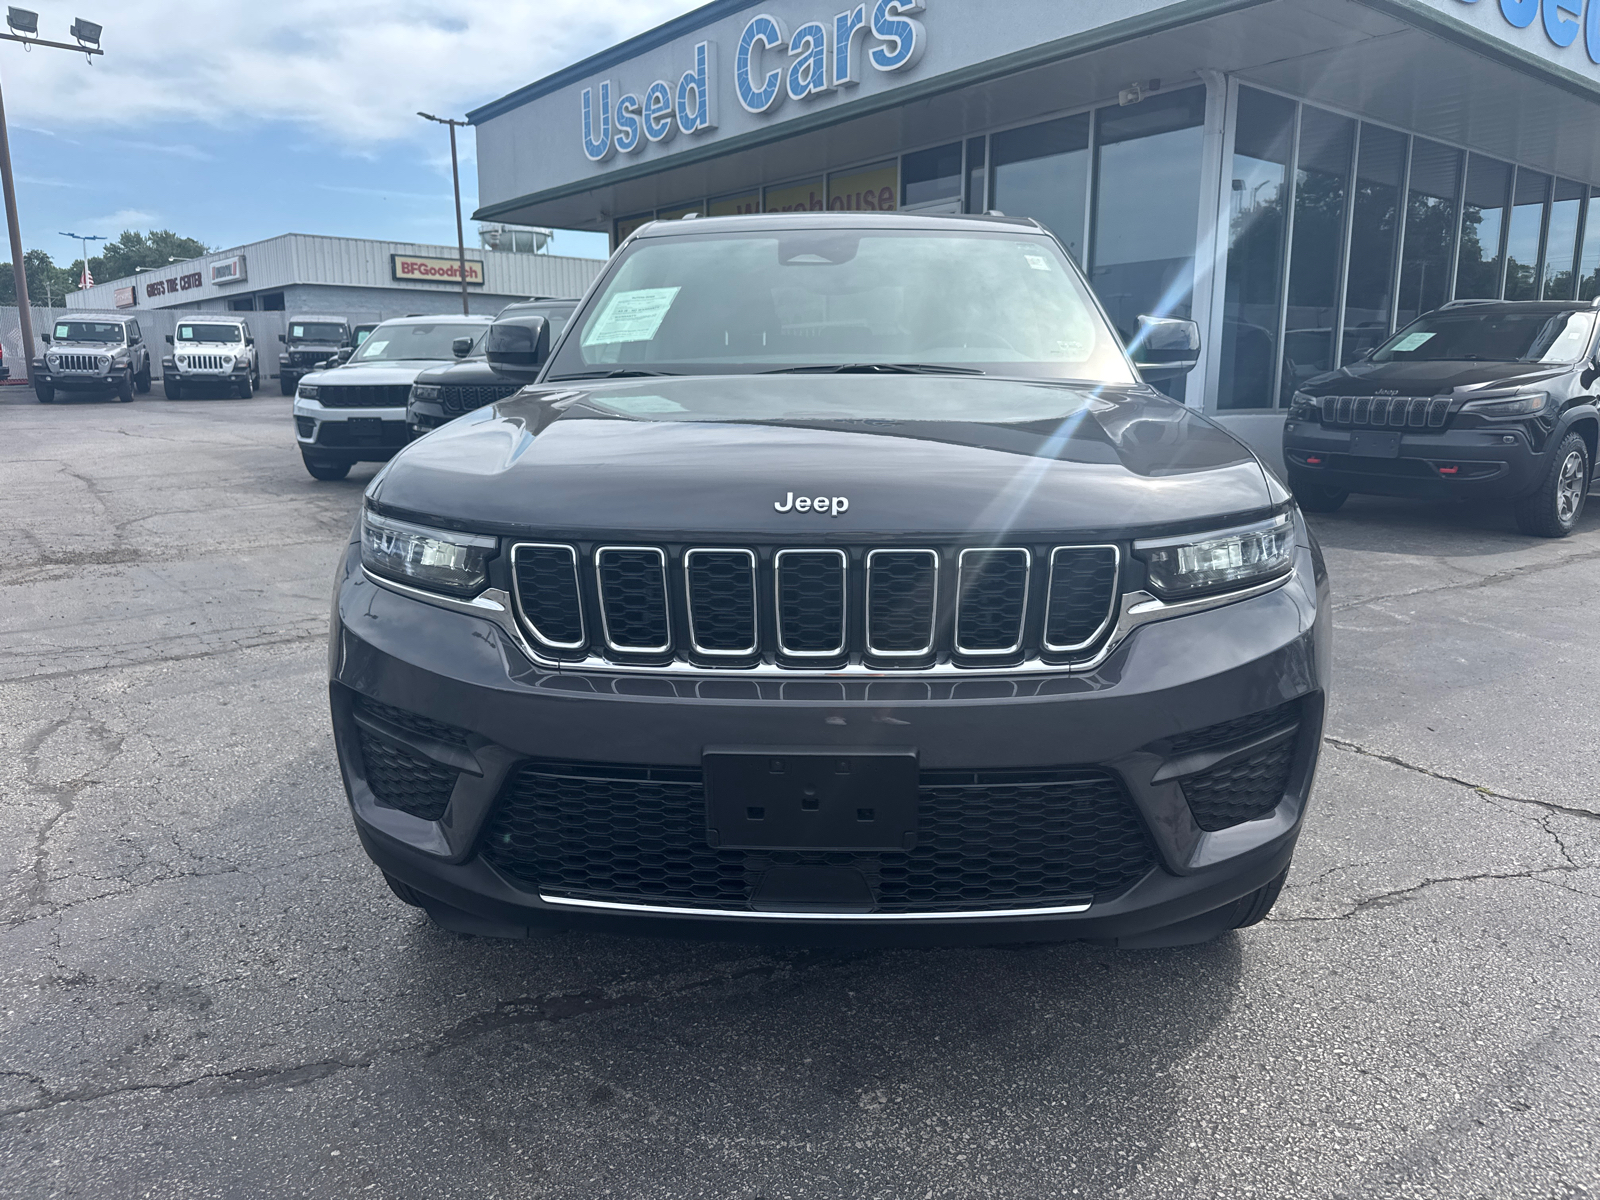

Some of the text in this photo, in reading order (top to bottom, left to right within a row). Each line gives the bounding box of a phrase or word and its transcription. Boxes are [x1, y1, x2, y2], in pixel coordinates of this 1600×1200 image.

[582, 0, 922, 162] Used Cars
[166, 277, 179, 293] TIRE
[180, 272, 203, 290] CENTER
[774, 492, 849, 517] Jeep
